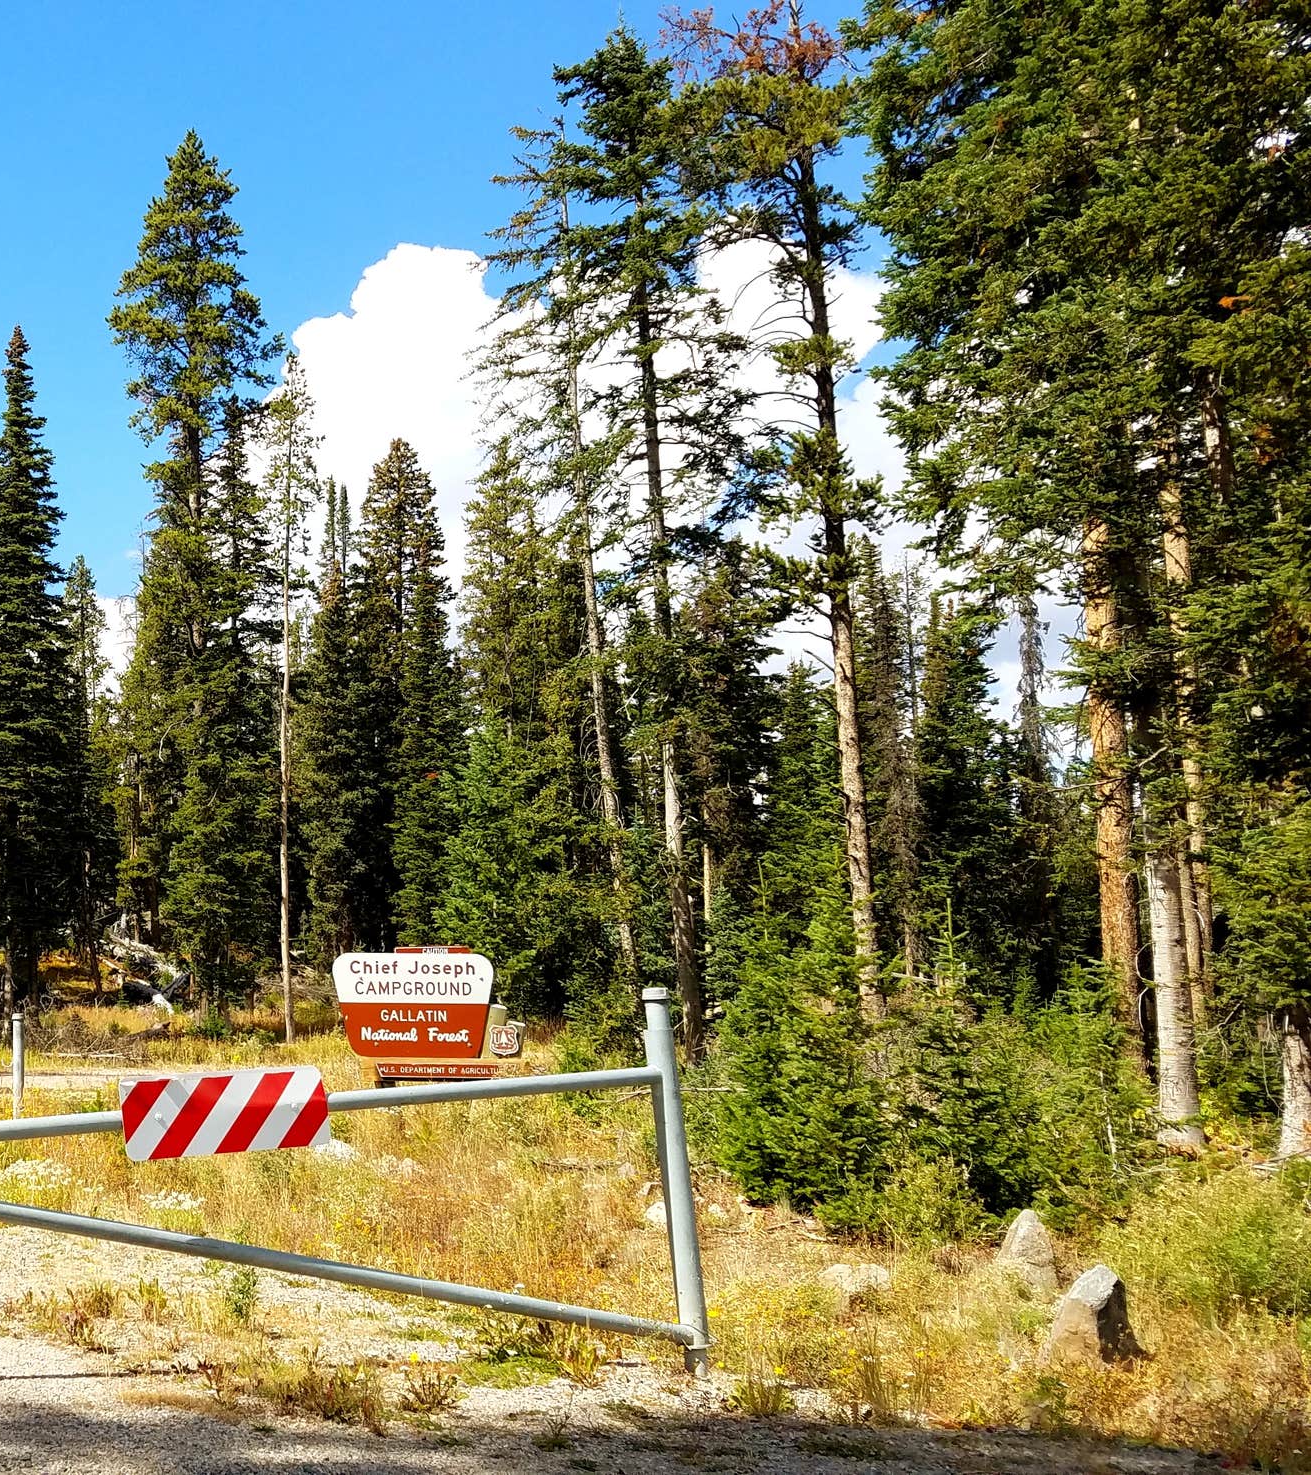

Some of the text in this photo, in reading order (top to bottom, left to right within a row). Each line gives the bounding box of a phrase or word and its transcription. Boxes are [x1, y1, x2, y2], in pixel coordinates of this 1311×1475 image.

[350, 961, 476, 978] Chief Joseph
[355, 981, 472, 996] CAMPGROUND
[380, 1009, 448, 1022] GALLATIN
[361, 1026, 470, 1042] National Forest
[400, 1066, 446, 1074] DEPARTMENT
[461, 1067, 499, 1075] AGRICULTU
